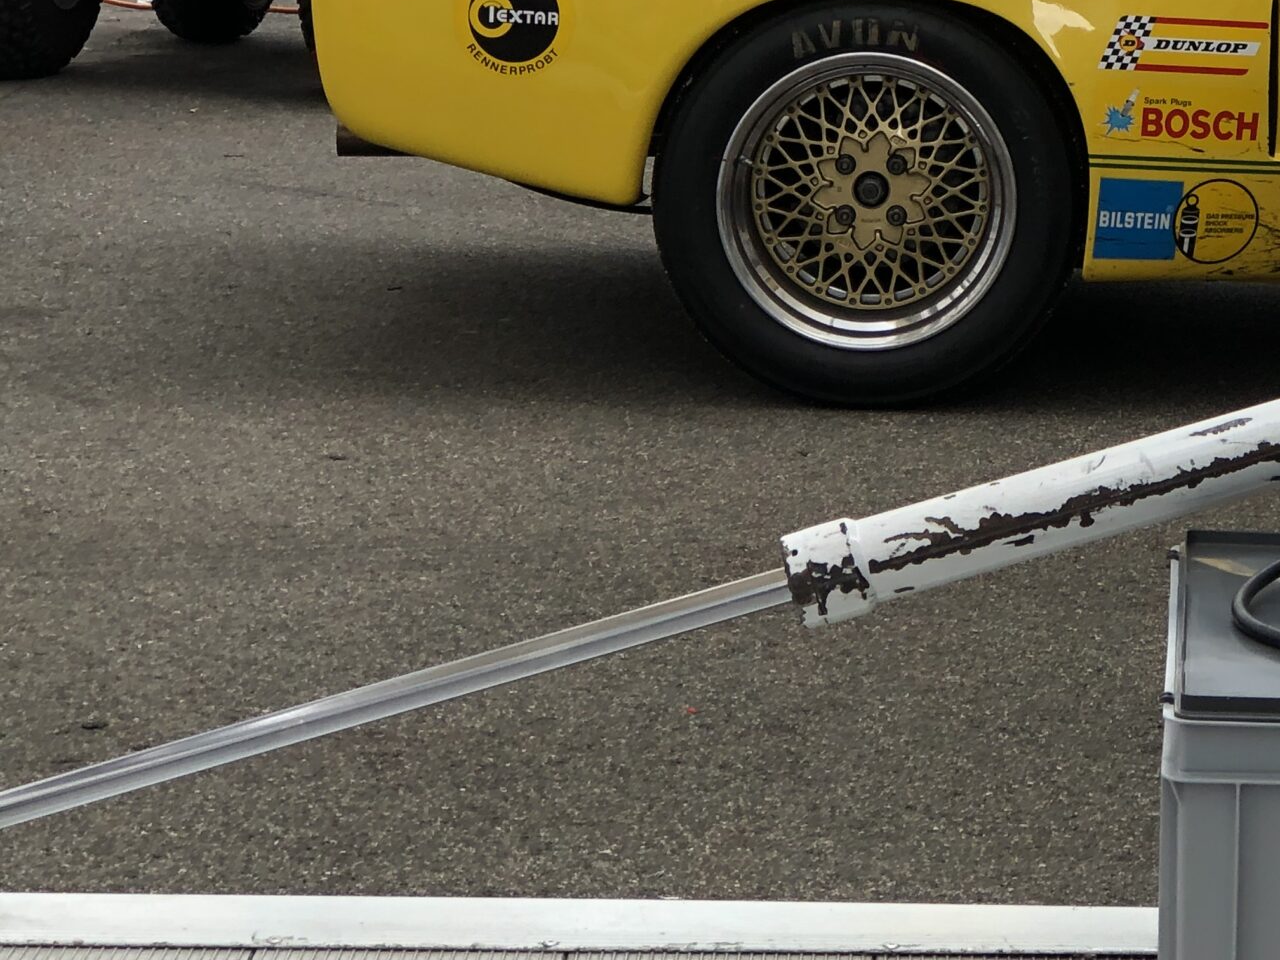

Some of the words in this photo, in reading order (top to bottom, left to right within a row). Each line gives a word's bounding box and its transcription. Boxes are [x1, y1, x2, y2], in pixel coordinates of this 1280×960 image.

[484, 1, 559, 26] TEXTAR
[791, 17, 920, 58] AVON
[1153, 39, 1248, 54] DUNLOP
[466, 43, 559, 75] RENNERPROBT
[1144, 96, 1167, 106] Spark
[1170, 97, 1192, 108] Plugs
[1141, 107, 1260, 141] BOSCH
[1099, 210, 1171, 230] BILSTEIN
